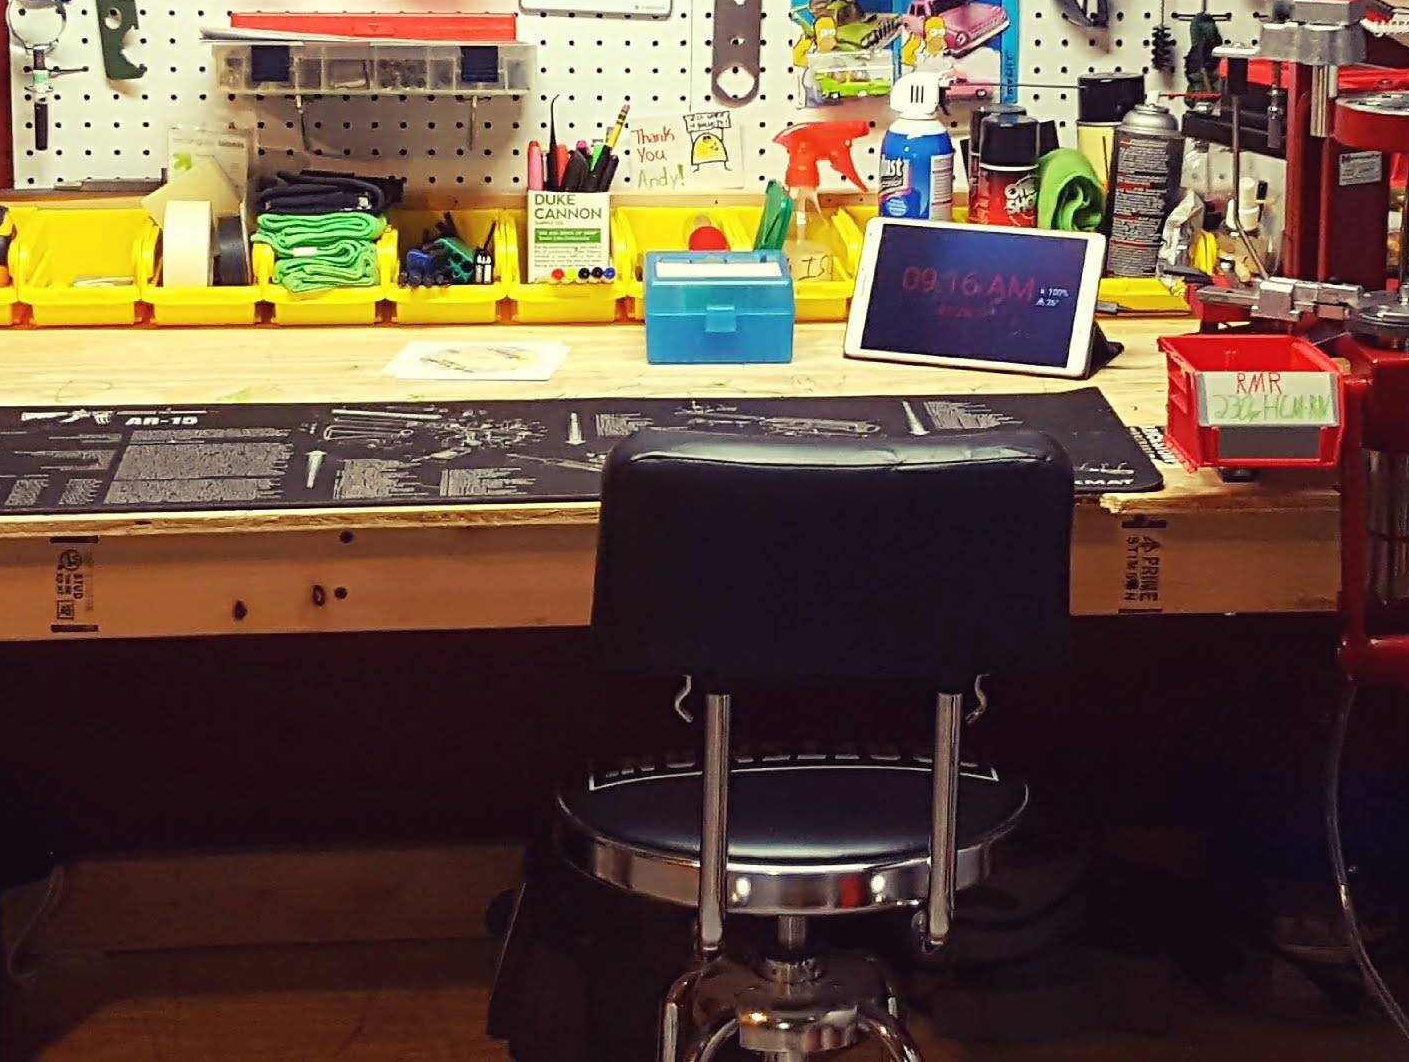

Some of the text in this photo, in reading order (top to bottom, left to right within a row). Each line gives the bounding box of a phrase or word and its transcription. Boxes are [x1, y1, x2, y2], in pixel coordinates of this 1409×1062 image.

[631, 126, 675, 145] Thank
[637, 147, 667, 162] You
[637, 164, 686, 189] Andy!
[535, 194, 575, 206] DUKE
[535, 208, 602, 220] CANNON
[1236, 372, 1283, 394] RMR
[125, 415, 198, 427] AR-15
[1139, 556, 1160, 602] PRIME
